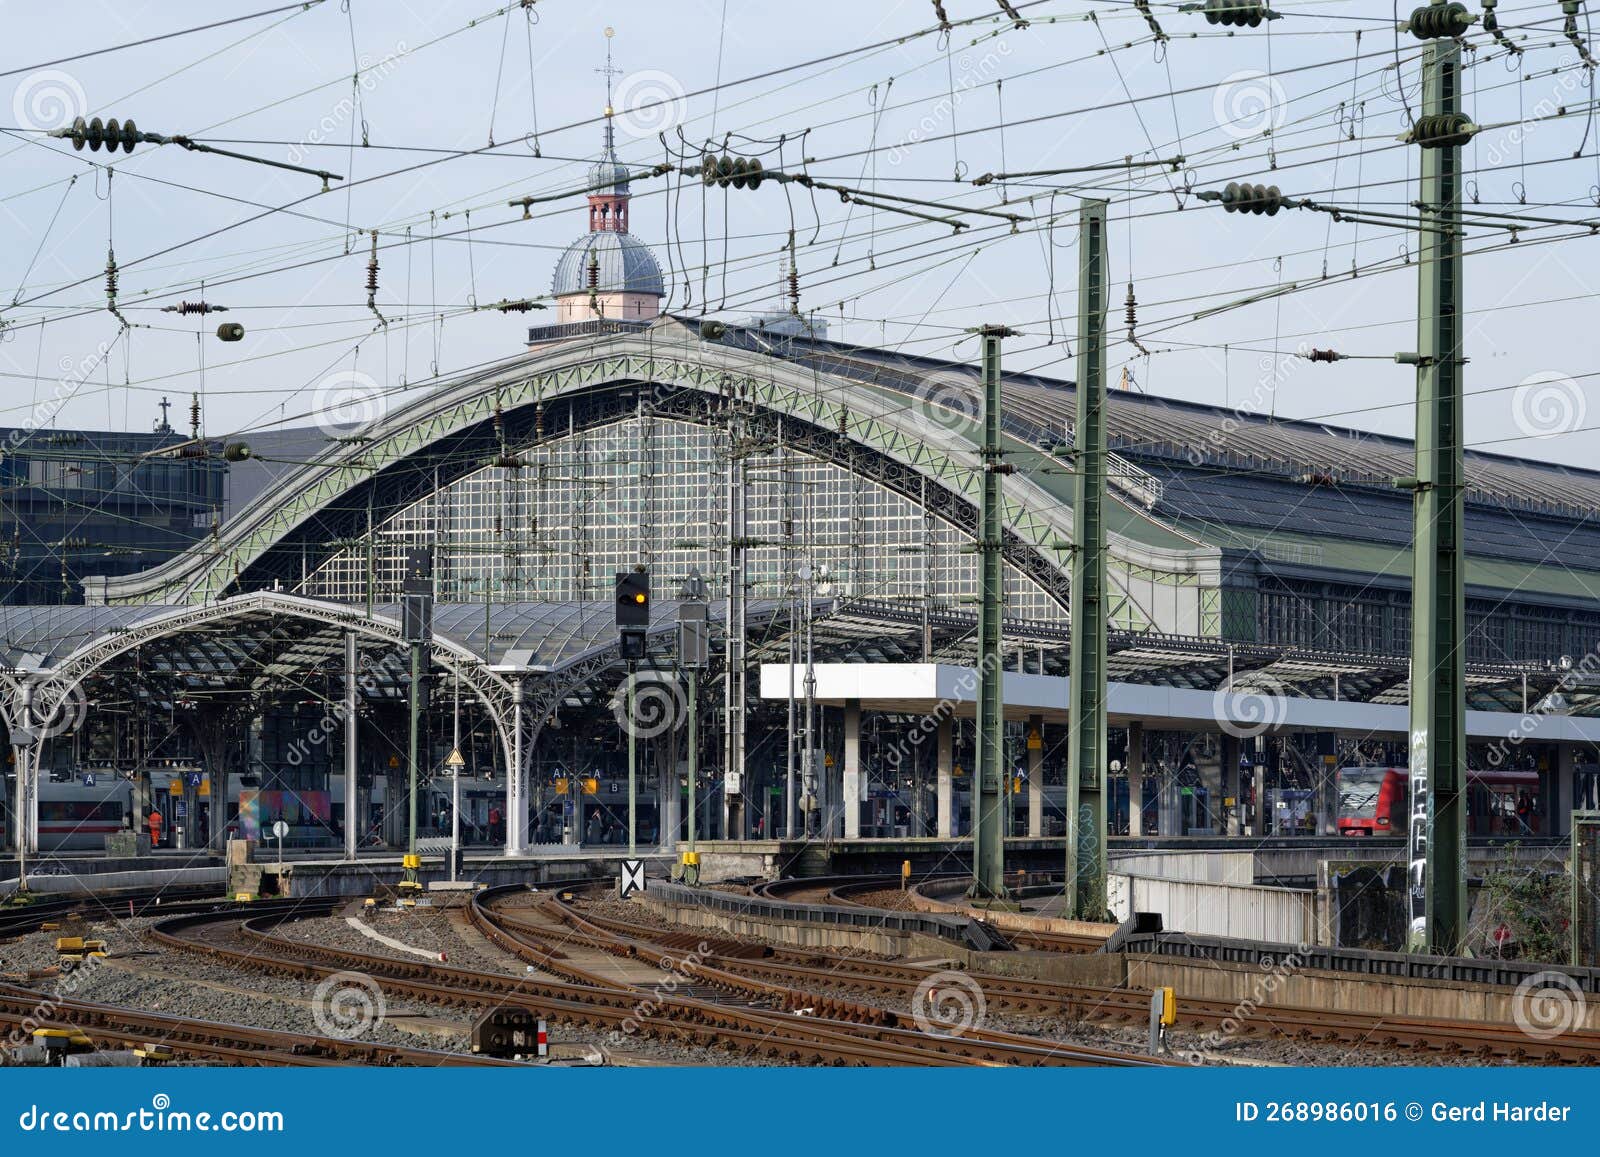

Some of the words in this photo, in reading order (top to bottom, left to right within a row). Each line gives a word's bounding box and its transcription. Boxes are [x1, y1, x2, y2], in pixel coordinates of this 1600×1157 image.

[553, 768, 561, 778] A
[1017, 767, 1025, 777] A
[86, 774, 94, 784] A
[192, 774, 200, 784] A
[611, 783, 618, 792] B
